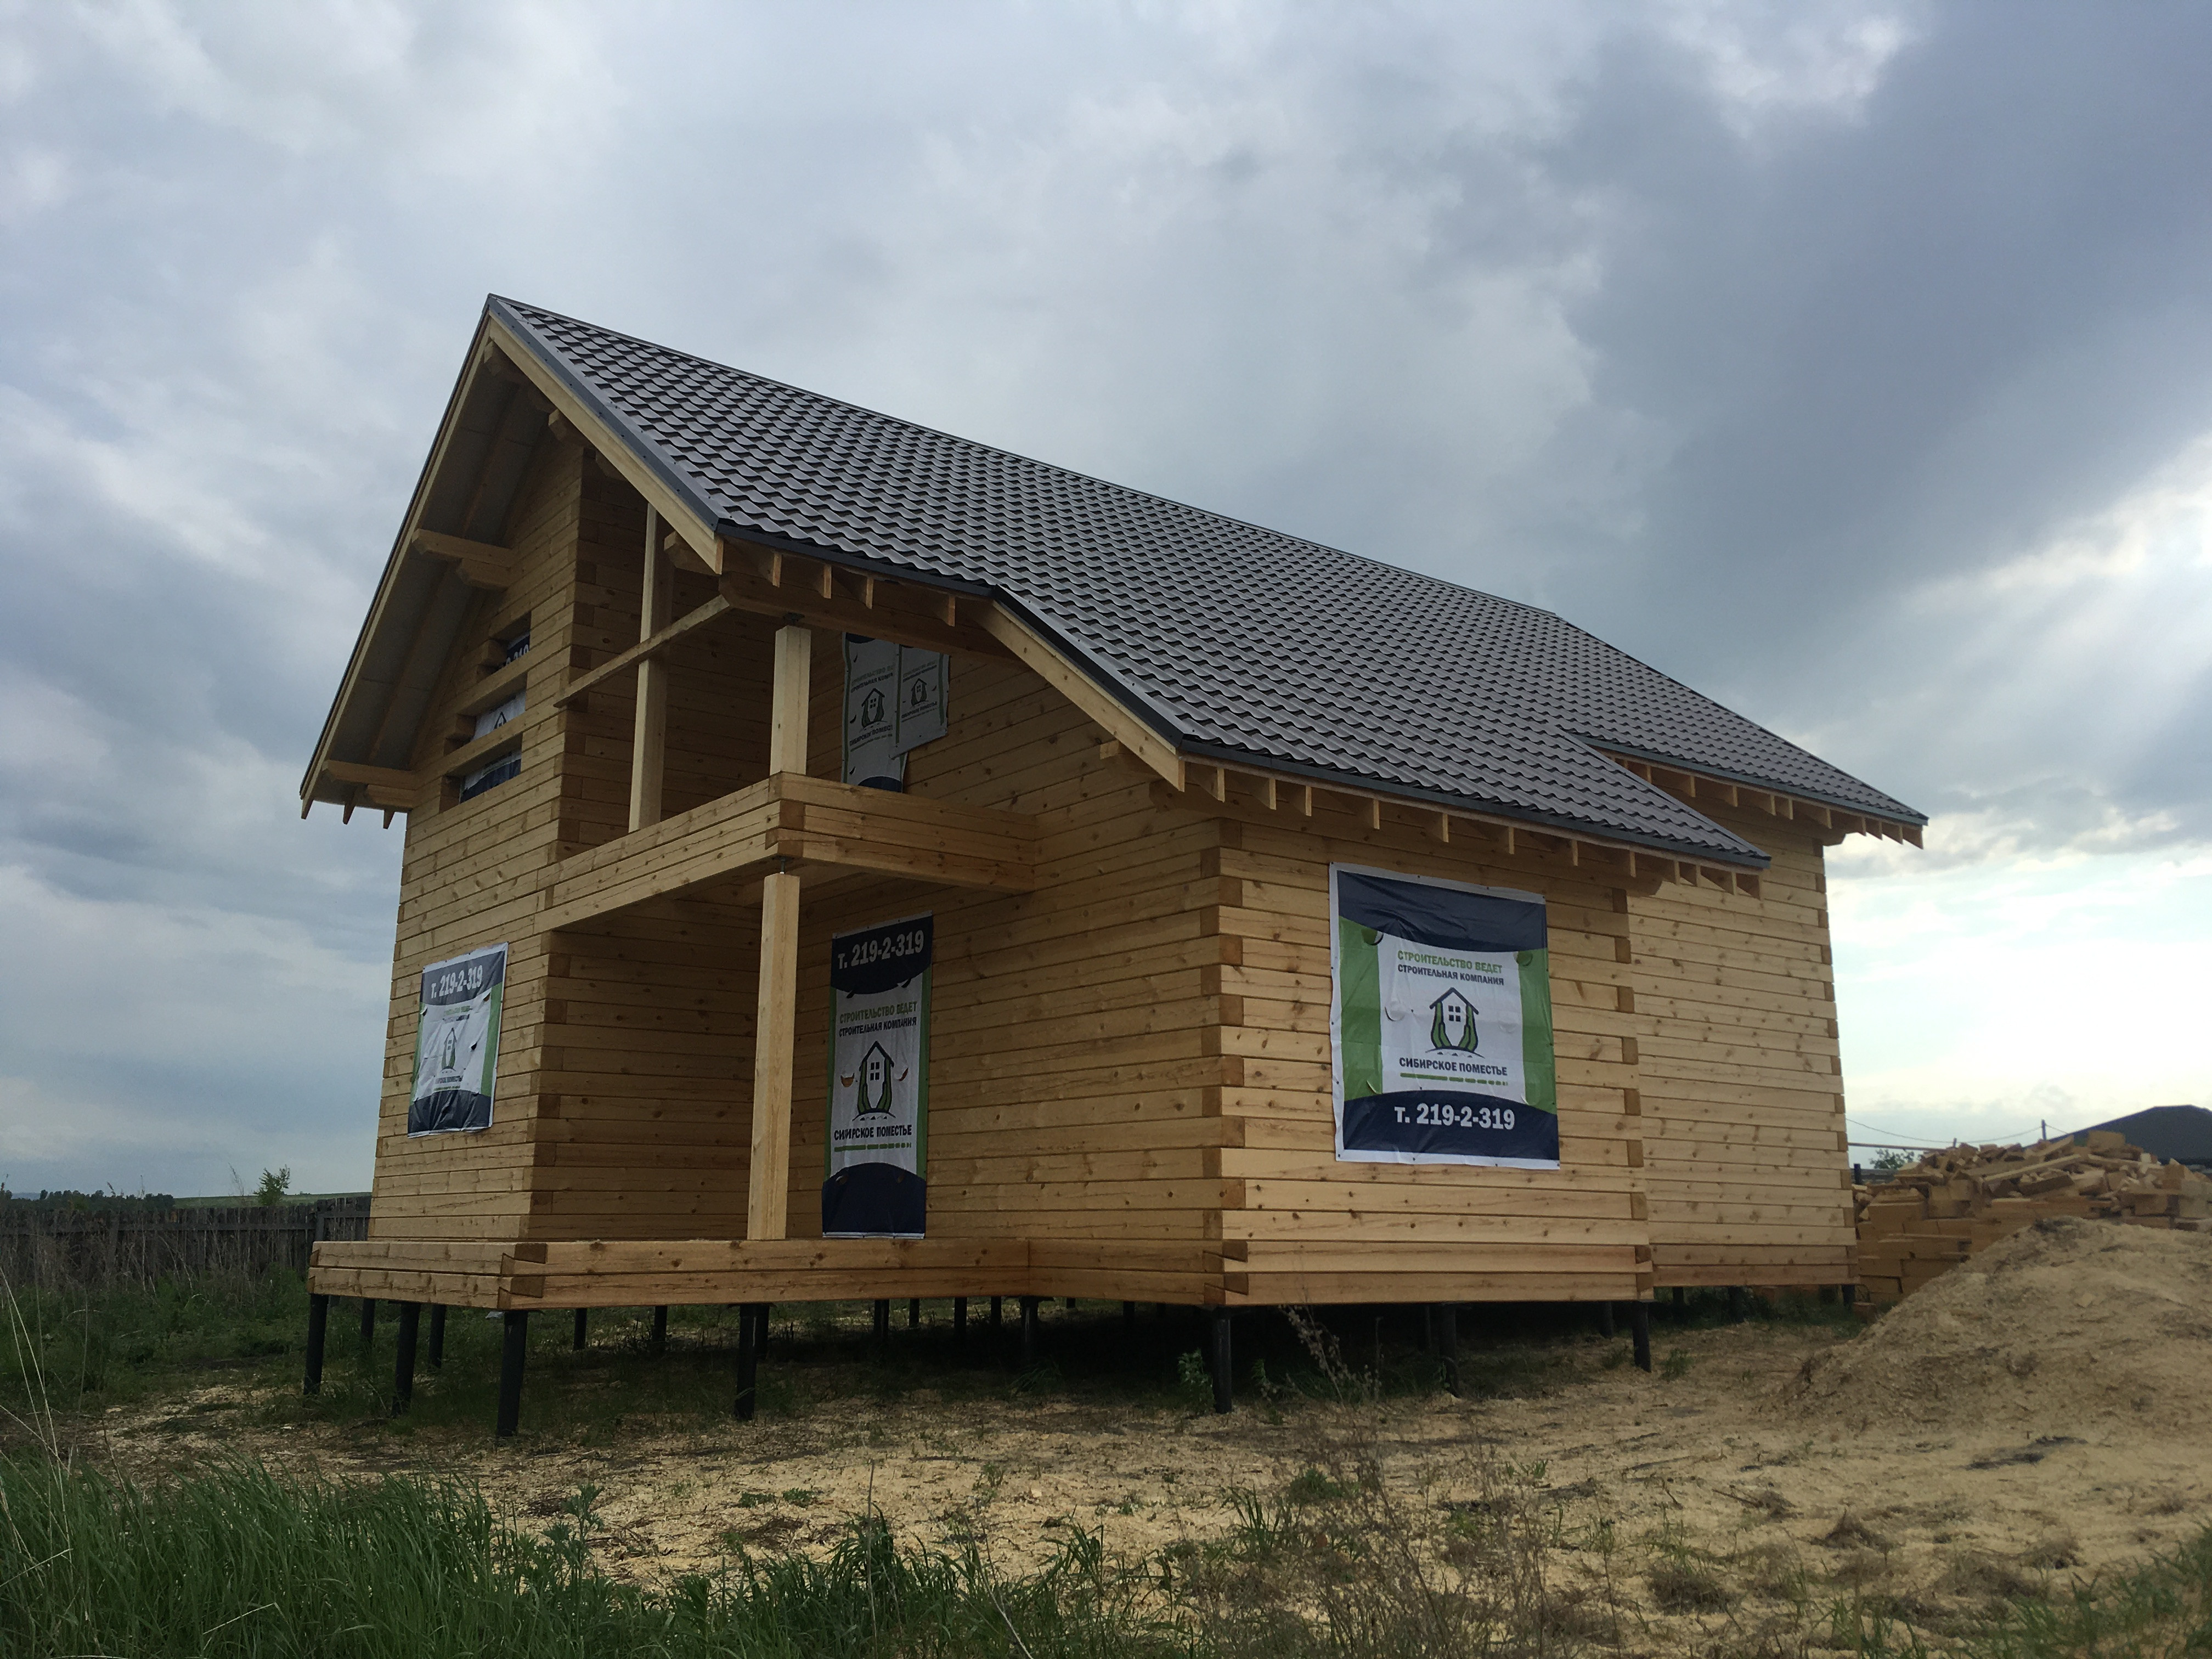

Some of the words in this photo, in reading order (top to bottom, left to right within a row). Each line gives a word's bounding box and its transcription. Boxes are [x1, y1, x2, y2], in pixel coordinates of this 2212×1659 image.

[850, 929, 924, 967] 219-2-319
[1397, 950, 1472, 969] СТРОИТЕЛЬСТВО
[1475, 962, 1502, 974] ВЕДЕТ
[439, 965, 483, 997] 219-2-319
[1398, 964, 1458, 979] СТРОИТЕЛЬНАЯ
[1460, 973, 1504, 985] КОМПАНИЯ
[840, 1005, 895, 1024] СТРОИТЕЛЬСТВО
[839, 1022, 882, 1037] СТРОИТЕЛЬНАЯ
[883, 1017, 917, 1030] КОМПАНИЯ
[1399, 1057, 1457, 1071] СИБИРСКОЕ
[1459, 1063, 1508, 1076] ПОМЕСТЬЕ
[1417, 1103, 1515, 1130] 219-2-319
[876, 1125, 912, 1138] ПОМЕСТЬЕ
